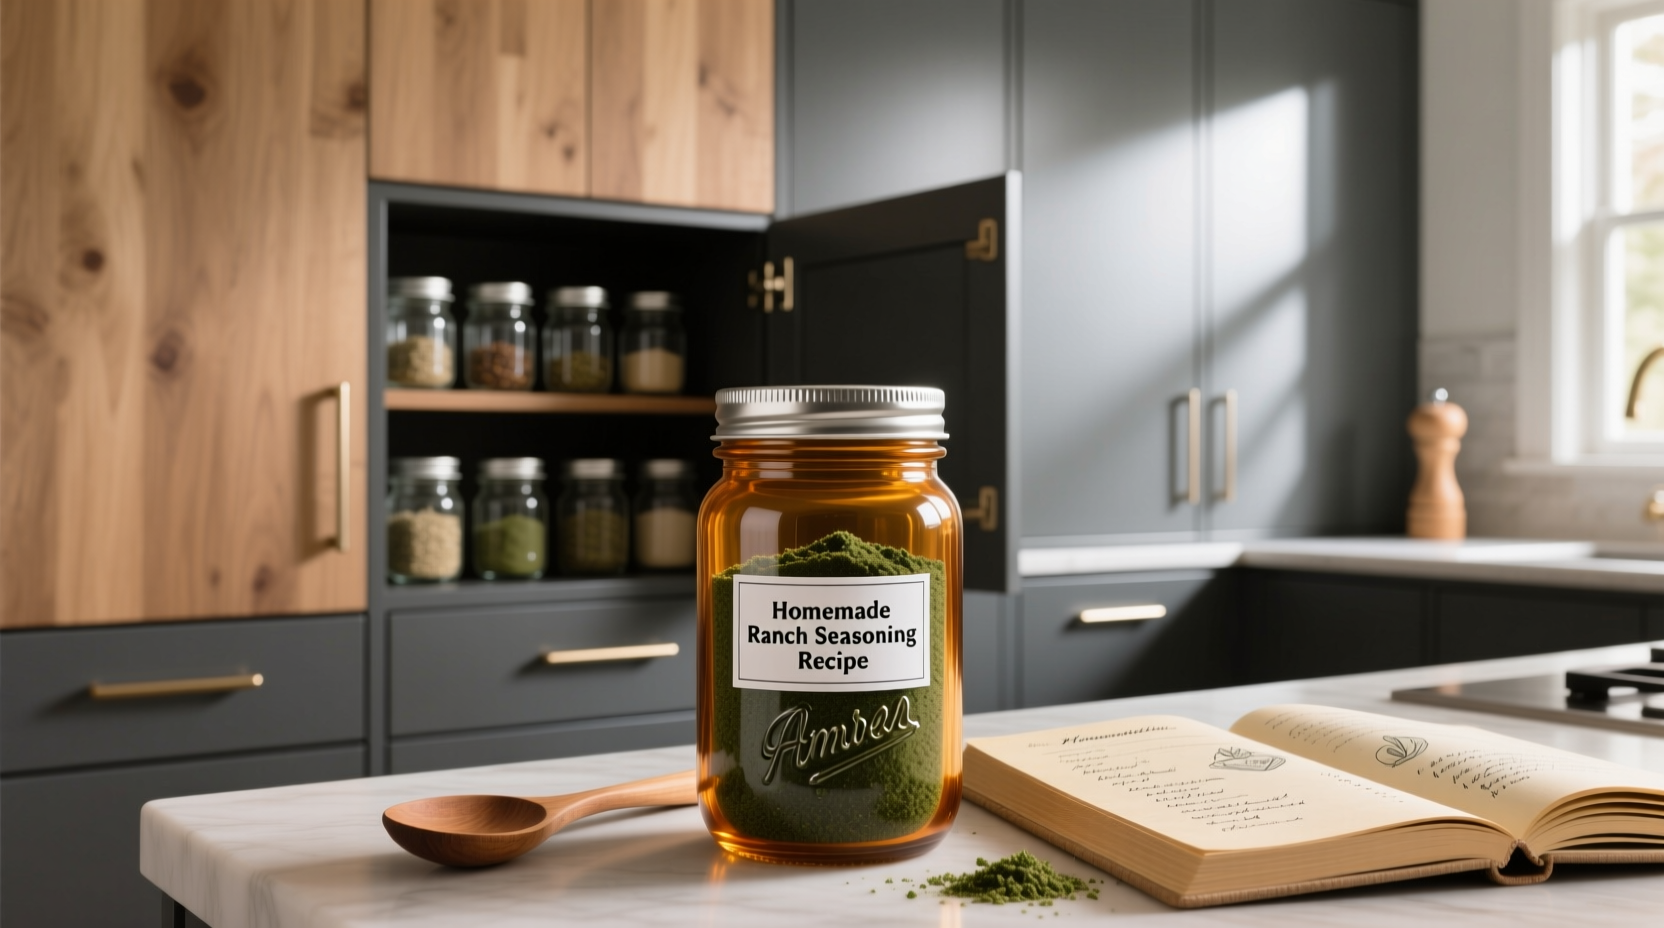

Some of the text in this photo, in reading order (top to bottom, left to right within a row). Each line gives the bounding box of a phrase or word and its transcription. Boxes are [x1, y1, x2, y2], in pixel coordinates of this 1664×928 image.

[772, 600, 891, 620] Homemade
[747, 625, 917, 648] Ranch Seasoning
[798, 651, 869, 675] Recipe
